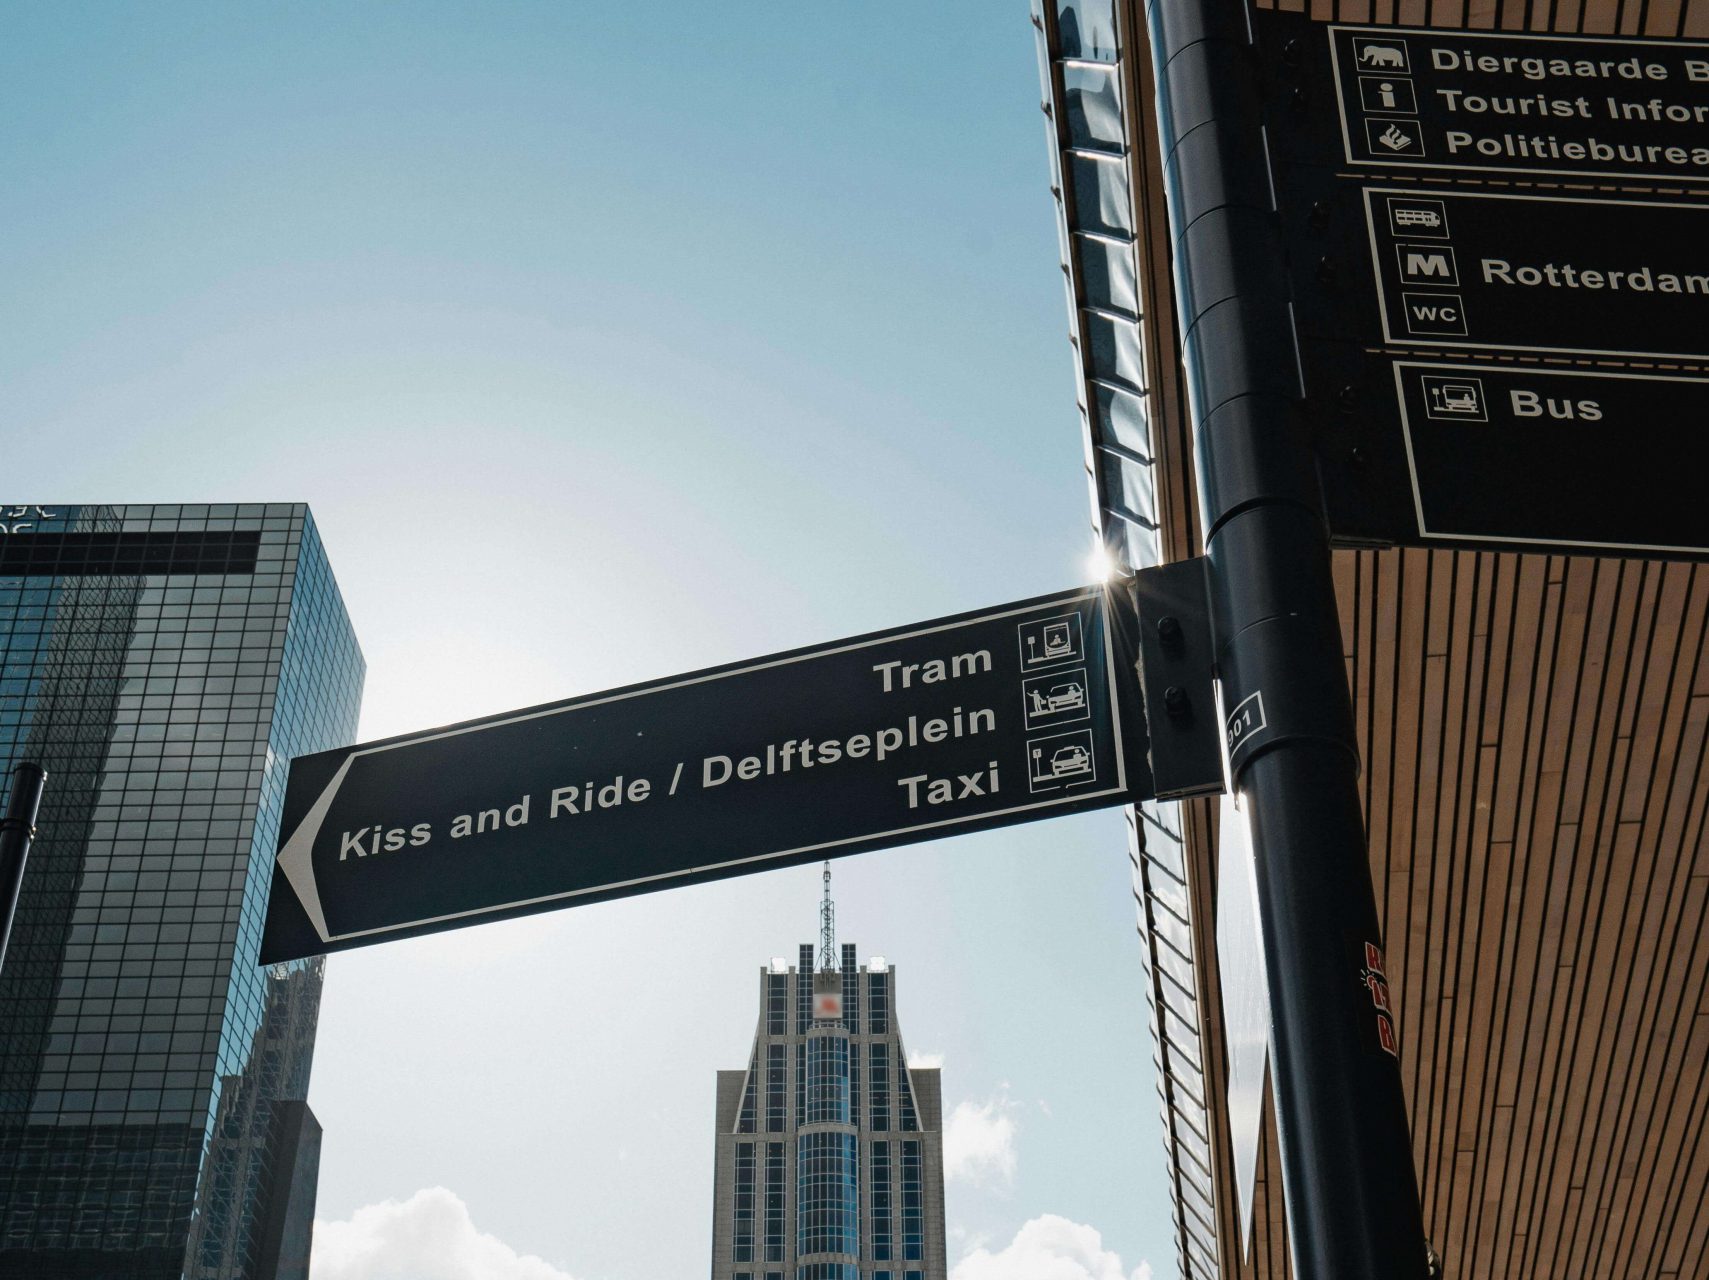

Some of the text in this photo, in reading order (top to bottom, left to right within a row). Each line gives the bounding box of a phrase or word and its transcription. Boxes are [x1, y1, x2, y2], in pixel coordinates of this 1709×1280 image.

[1431, 48, 1669, 80] Diergaarde
[1436, 89, 1709, 123] Tourist Infor
[1446, 131, 1709, 165] Politieburea
[1481, 258, 1709, 295] Rotterdam
[1413, 305, 1457, 323] WC
[1509, 390, 1603, 421] Bus
[872, 649, 993, 693] Tram
[339, 706, 996, 861] Kiss and Ride / Delftseplein
[897, 760, 1000, 810] Taxi
